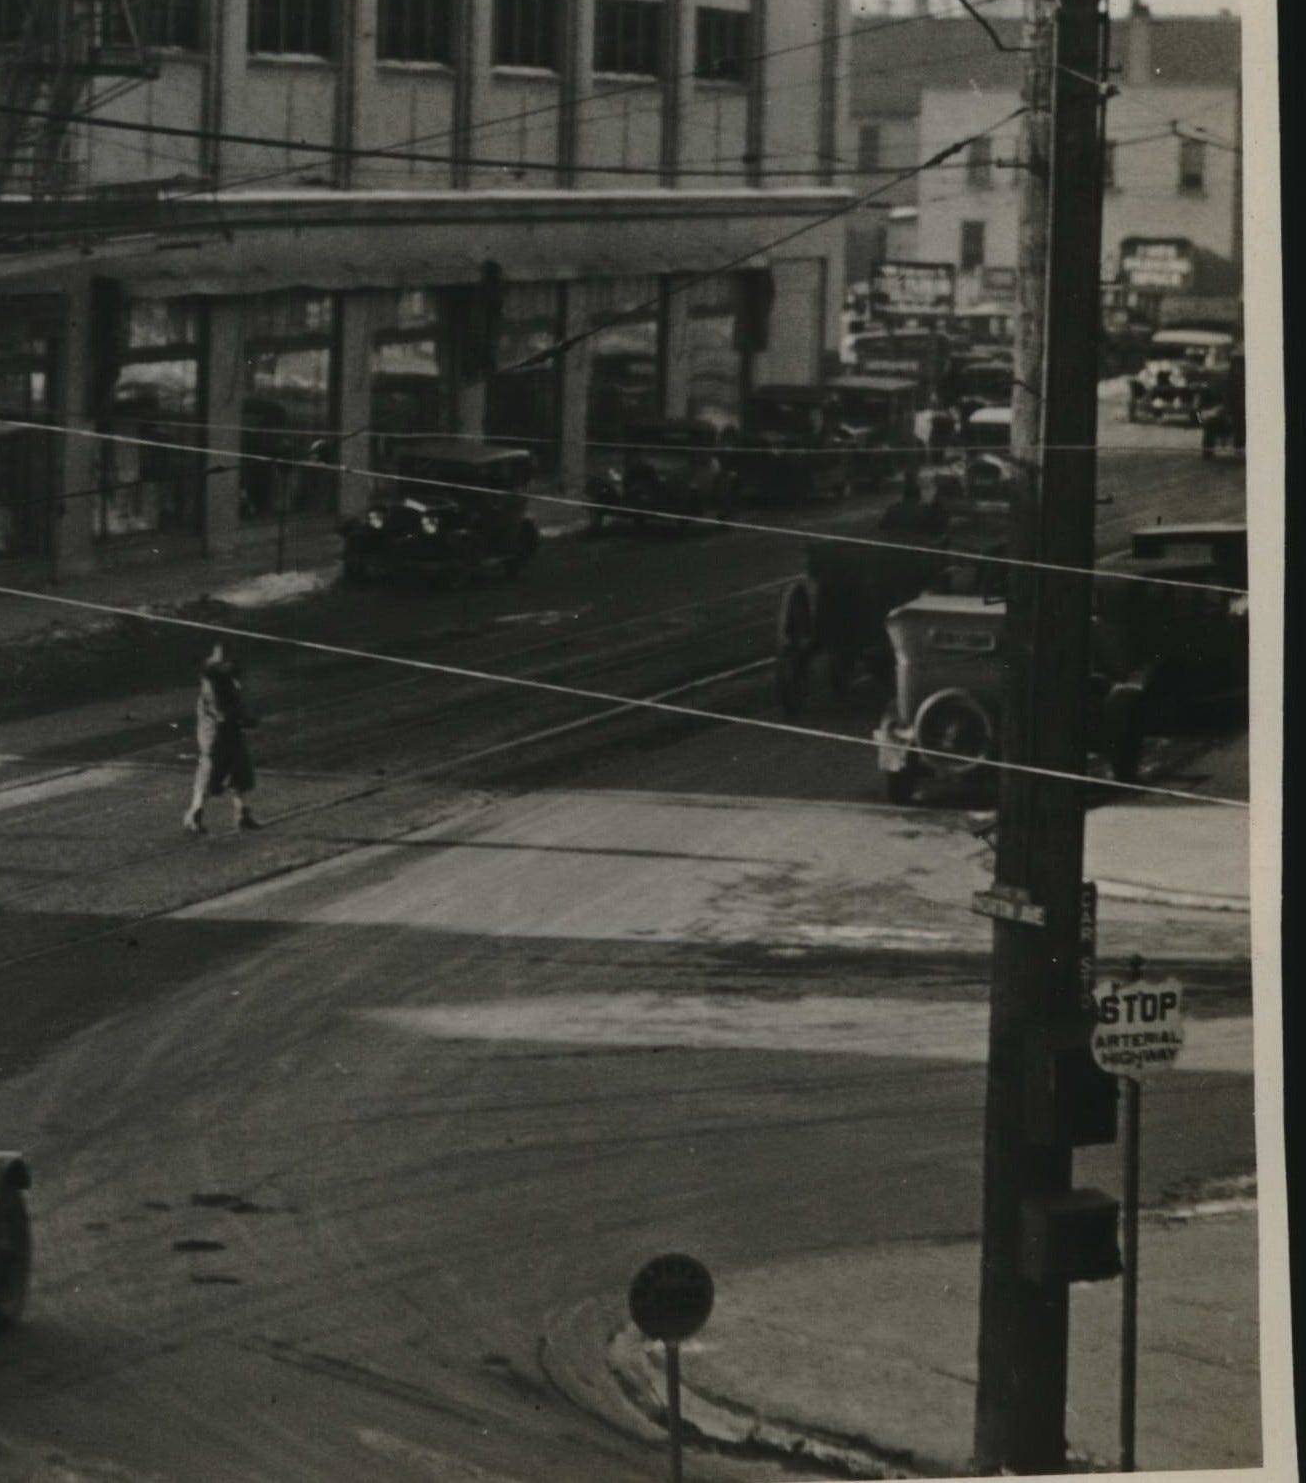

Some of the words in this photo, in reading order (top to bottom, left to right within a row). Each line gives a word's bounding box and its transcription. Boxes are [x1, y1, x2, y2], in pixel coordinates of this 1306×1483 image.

[1099, 991, 1177, 1025] STOP
[1094, 1030, 1183, 1050] ARTERIAL
[1100, 1047, 1179, 1066] HIGHWAY
